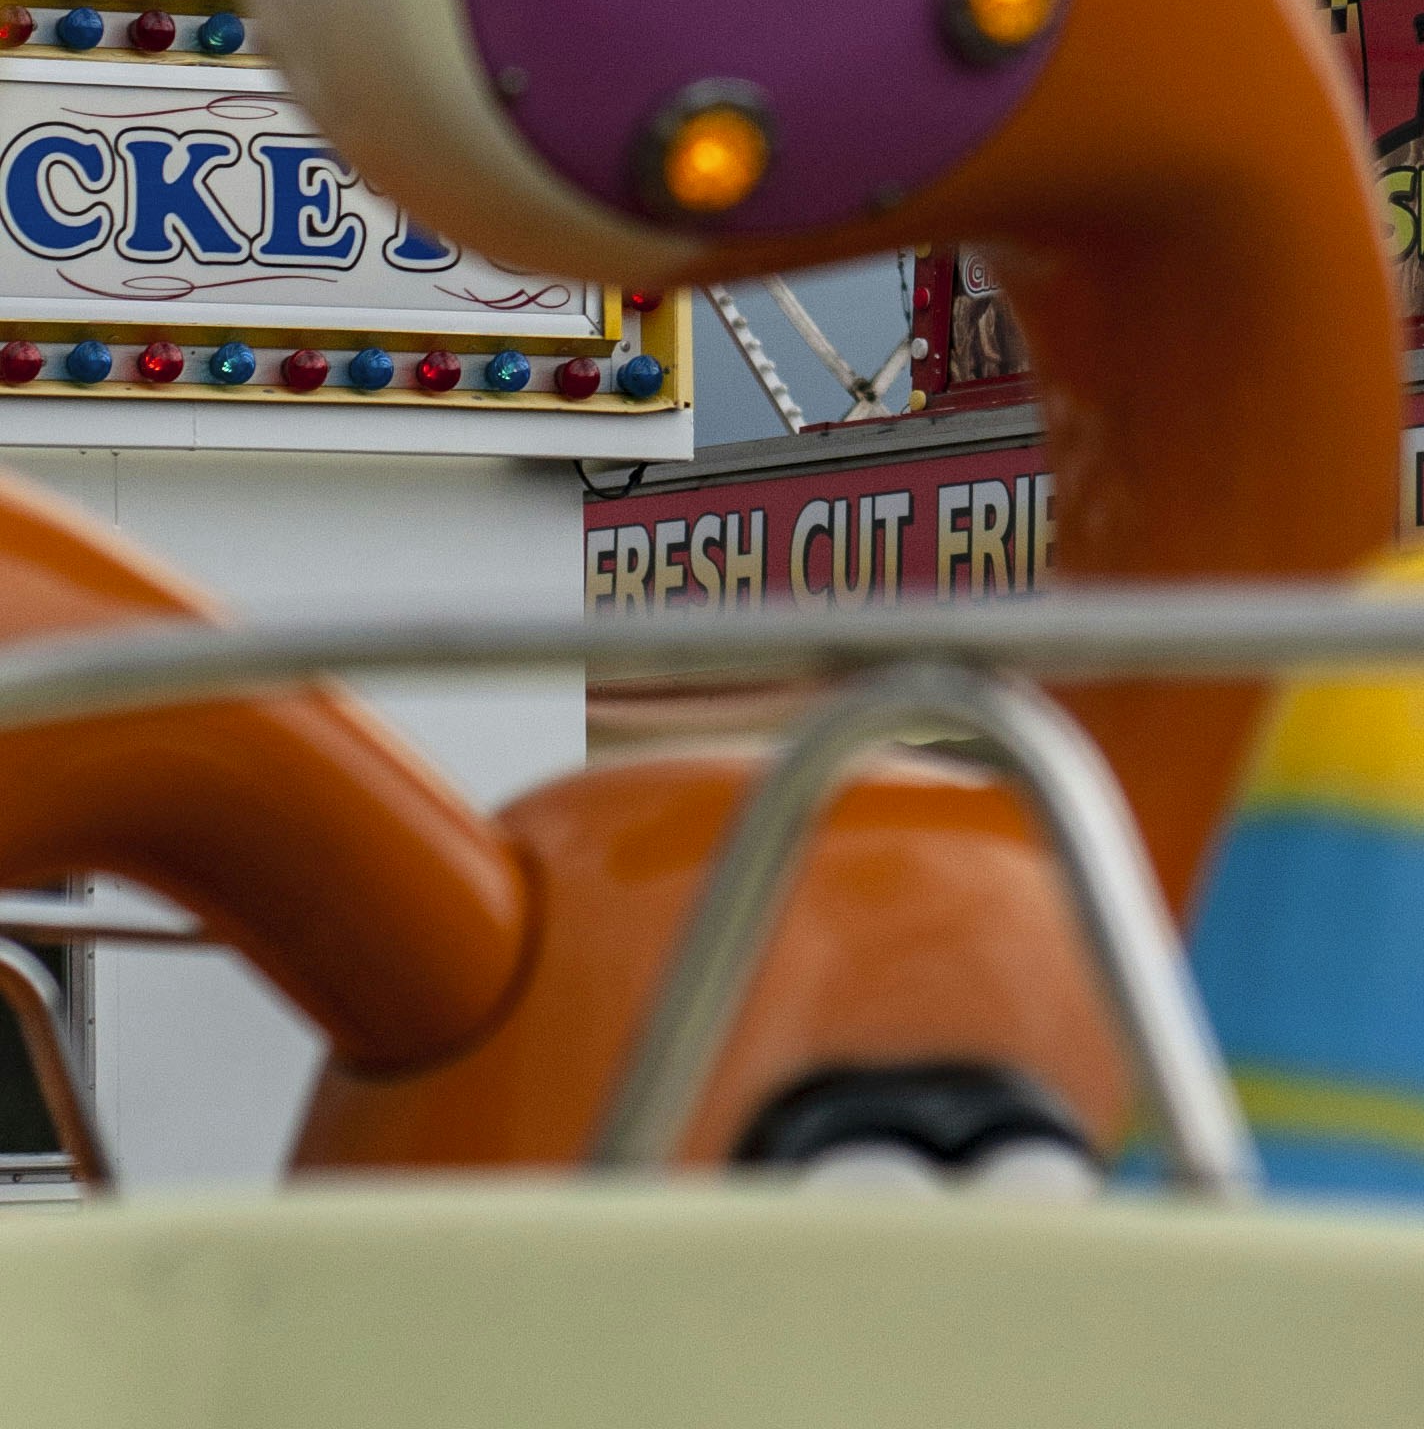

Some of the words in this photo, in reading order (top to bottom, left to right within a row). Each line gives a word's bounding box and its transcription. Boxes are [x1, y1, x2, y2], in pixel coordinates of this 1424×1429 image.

[584, 508, 766, 617] FRESH
[790, 490, 914, 611] CUT
[936, 472, 1057, 603] FRIE
